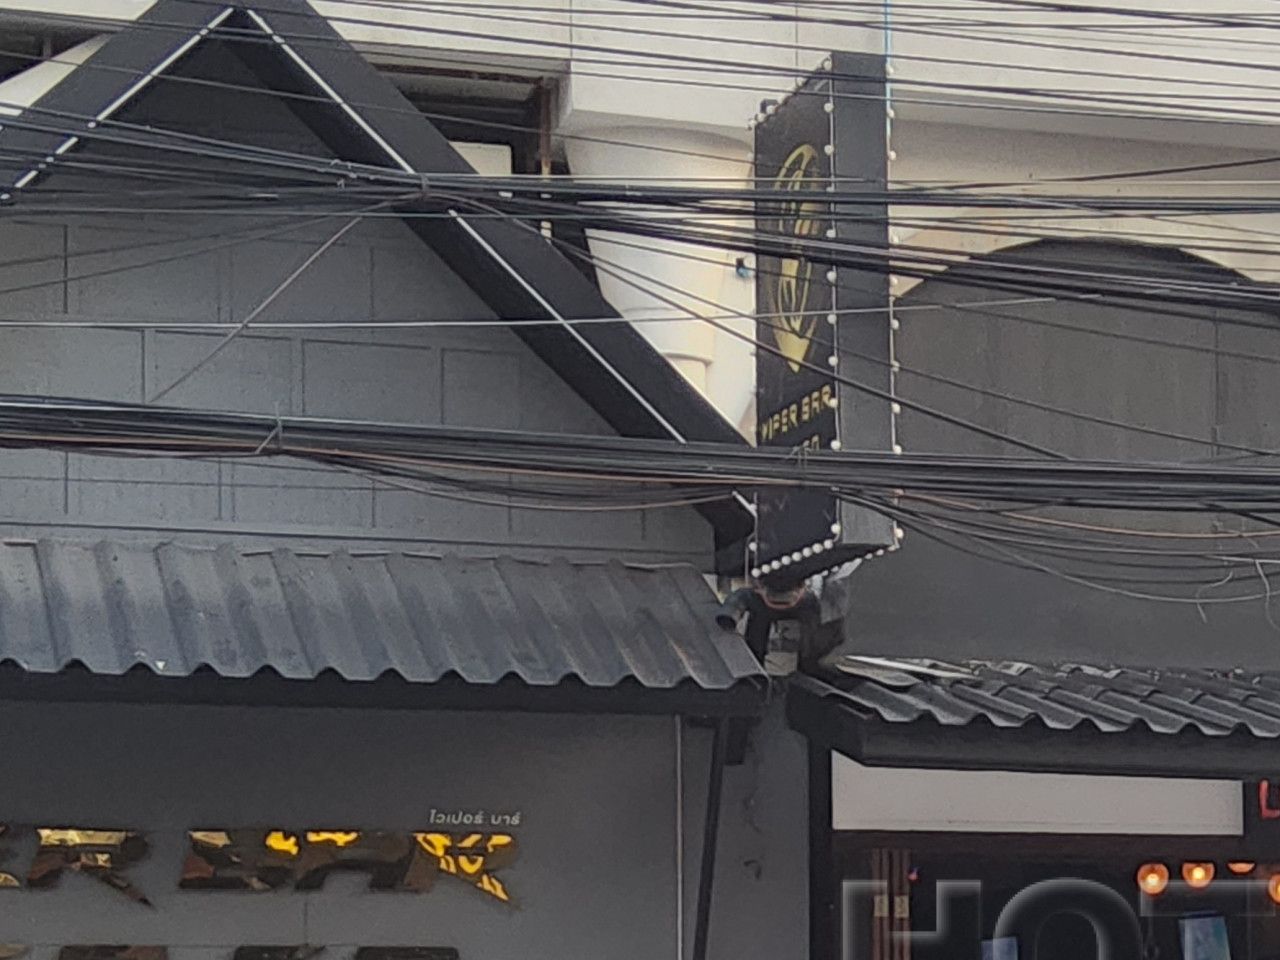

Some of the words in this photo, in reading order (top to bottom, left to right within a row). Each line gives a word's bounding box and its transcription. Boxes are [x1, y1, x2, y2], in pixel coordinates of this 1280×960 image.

[761, 404, 798, 442] VIPER
[802, 384, 835, 421] BAR
[490, 811, 521, 825] บาร์
